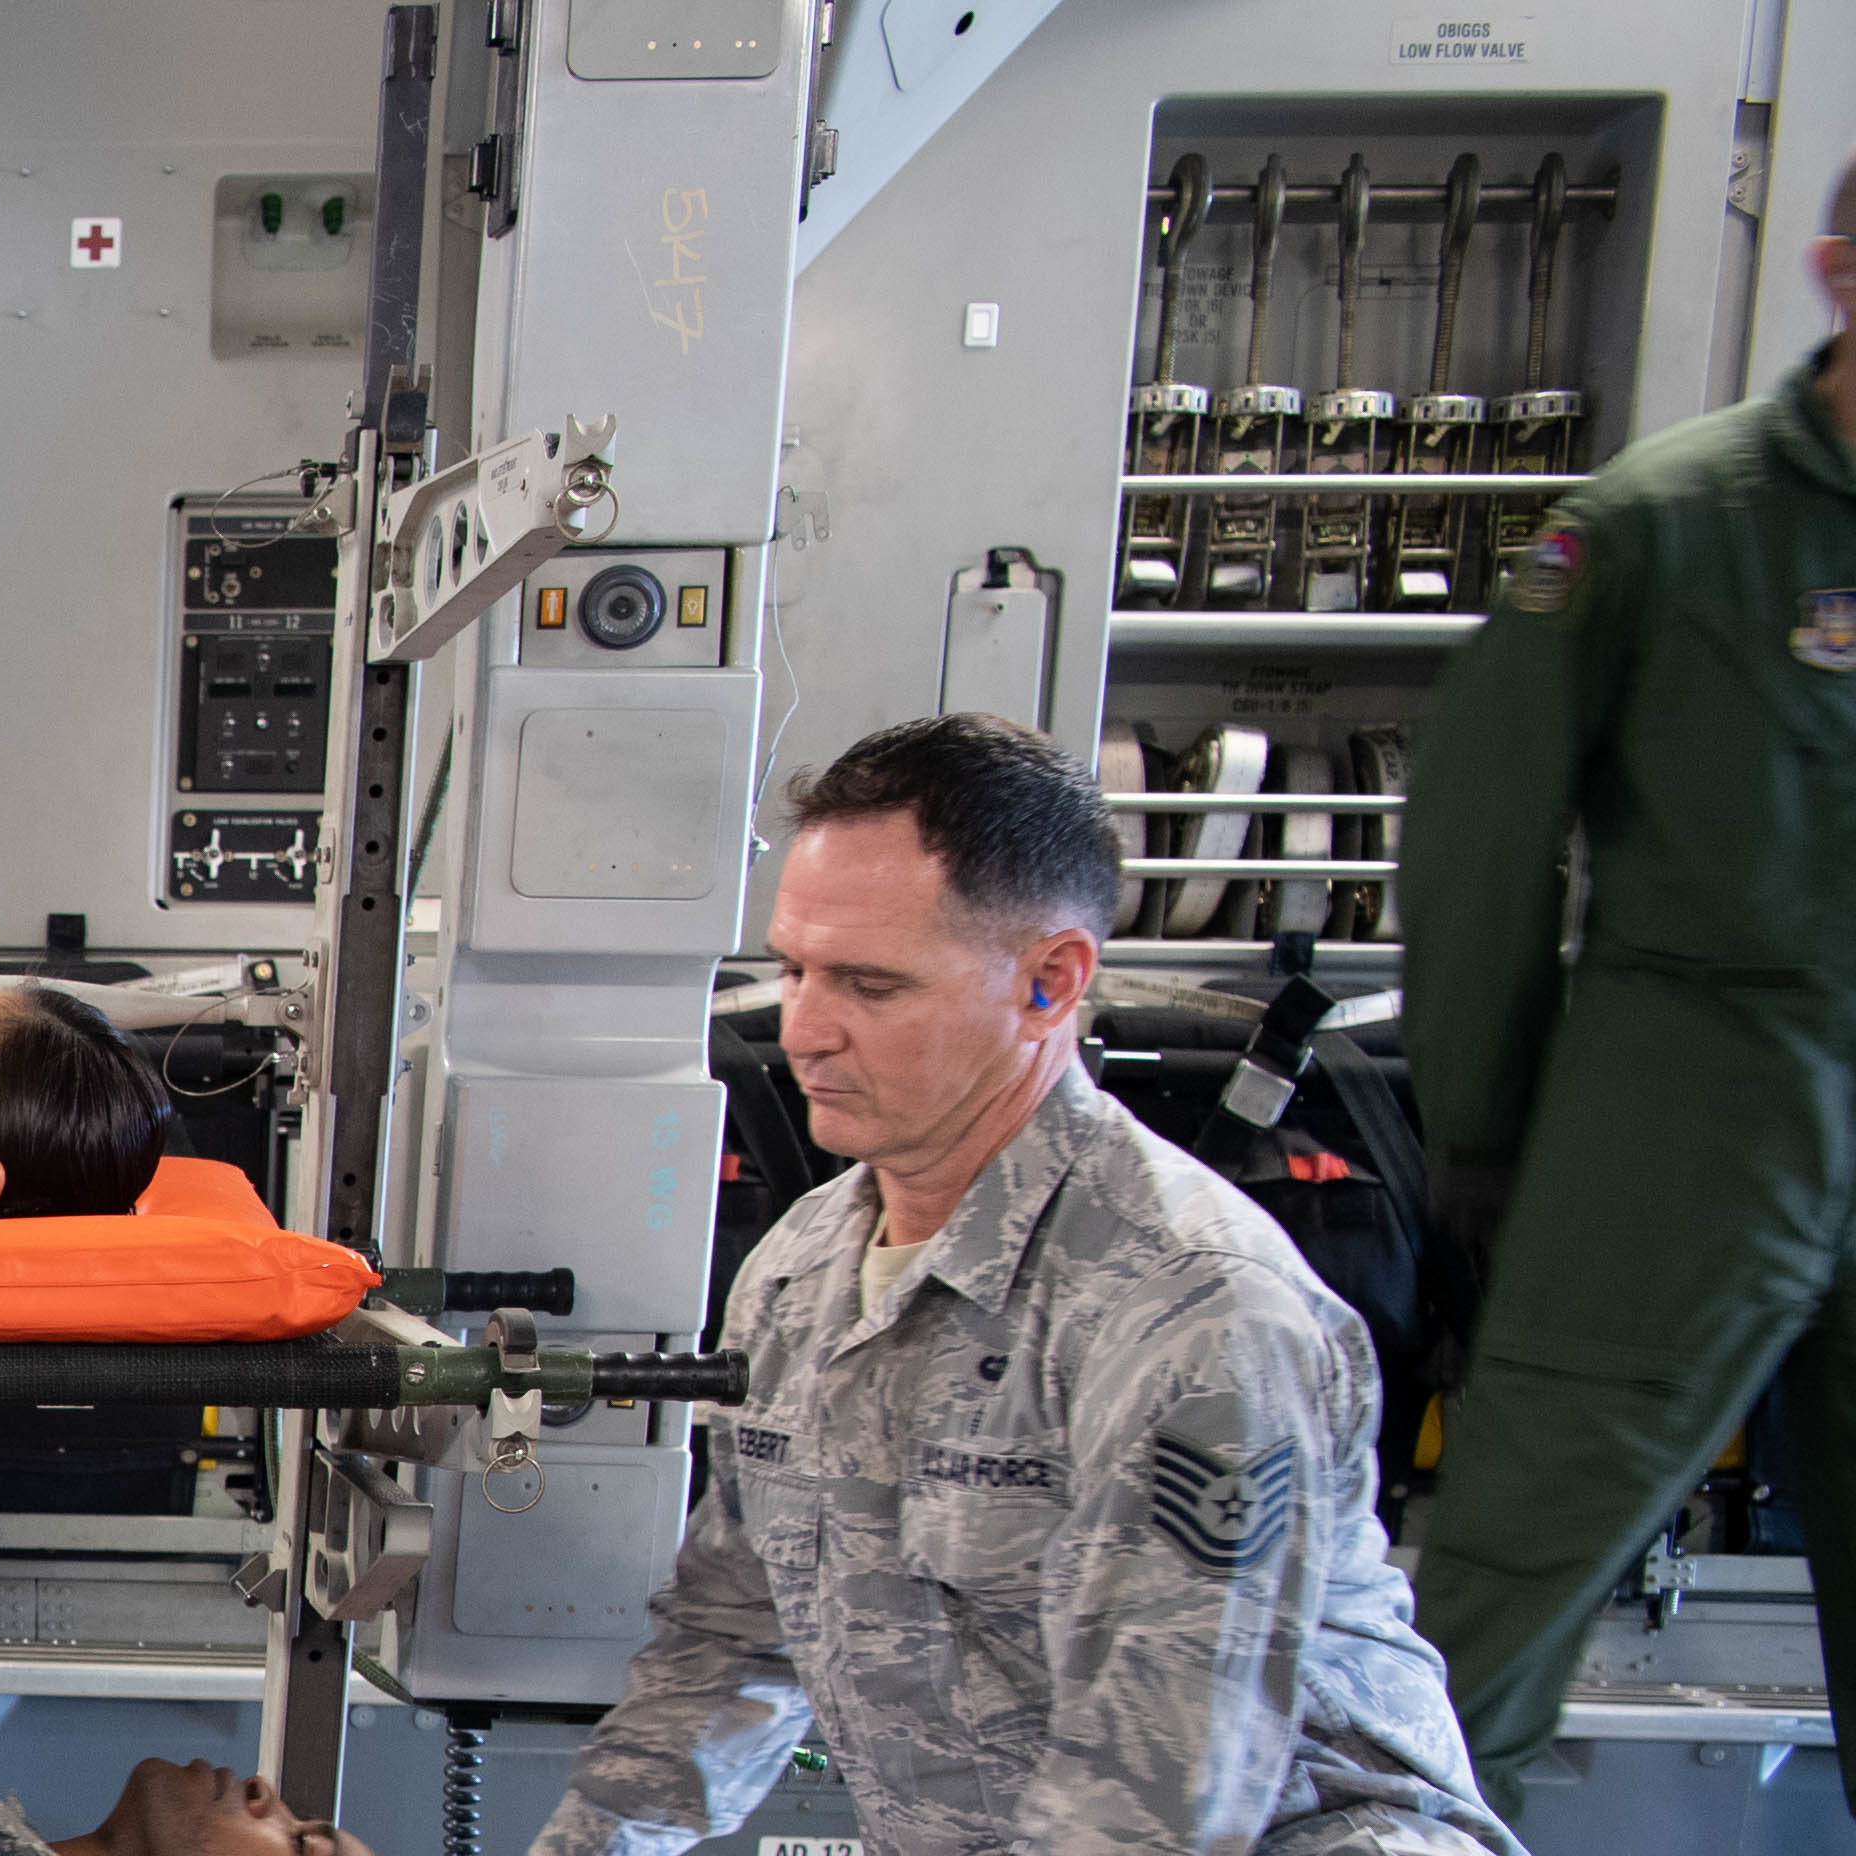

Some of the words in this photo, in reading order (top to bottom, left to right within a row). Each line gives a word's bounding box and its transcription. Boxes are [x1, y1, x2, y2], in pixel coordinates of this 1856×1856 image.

[1437, 23, 1491, 38] OBIGGS
[1399, 43, 1432, 58] LOW
[1435, 43, 1477, 58] FLOW
[1481, 43, 1526, 58] VALVE
[651, 1107, 682, 1150] 15
[646, 1167, 678, 1232] WG
